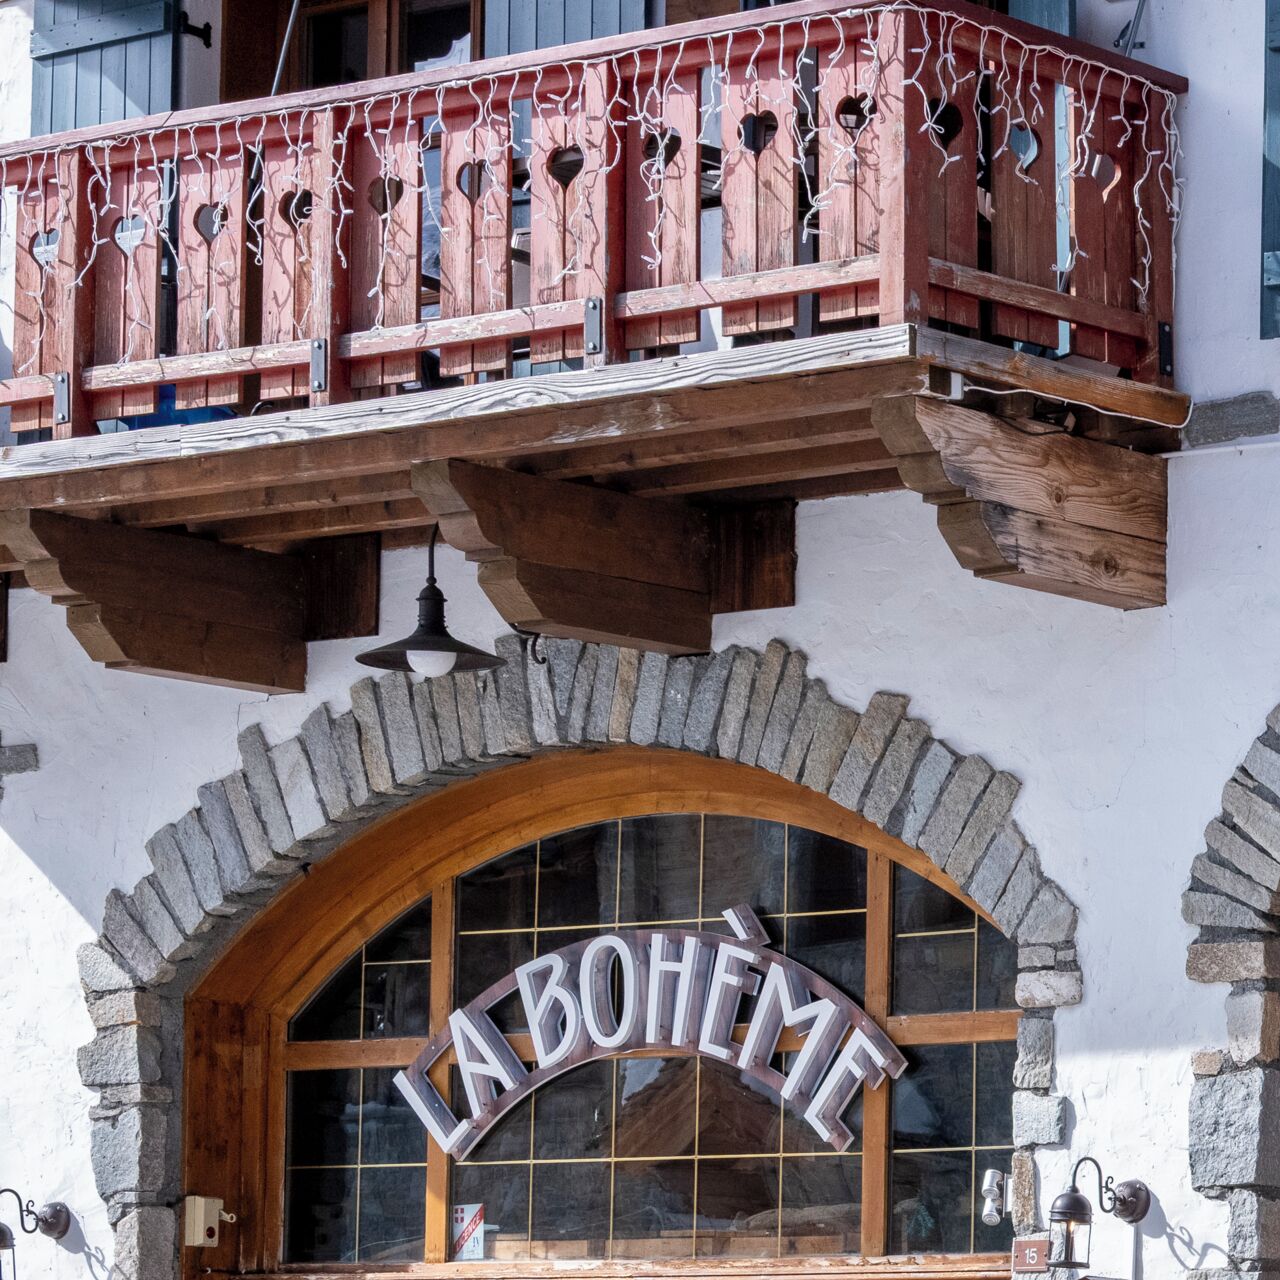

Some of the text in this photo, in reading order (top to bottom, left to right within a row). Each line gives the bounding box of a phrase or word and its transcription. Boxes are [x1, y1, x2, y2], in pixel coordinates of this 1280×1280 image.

[393, 903, 904, 1158] LA BOHÈME
[454, 1210, 483, 1252] LICENCE
[1024, 1247, 1038, 1264] 15
